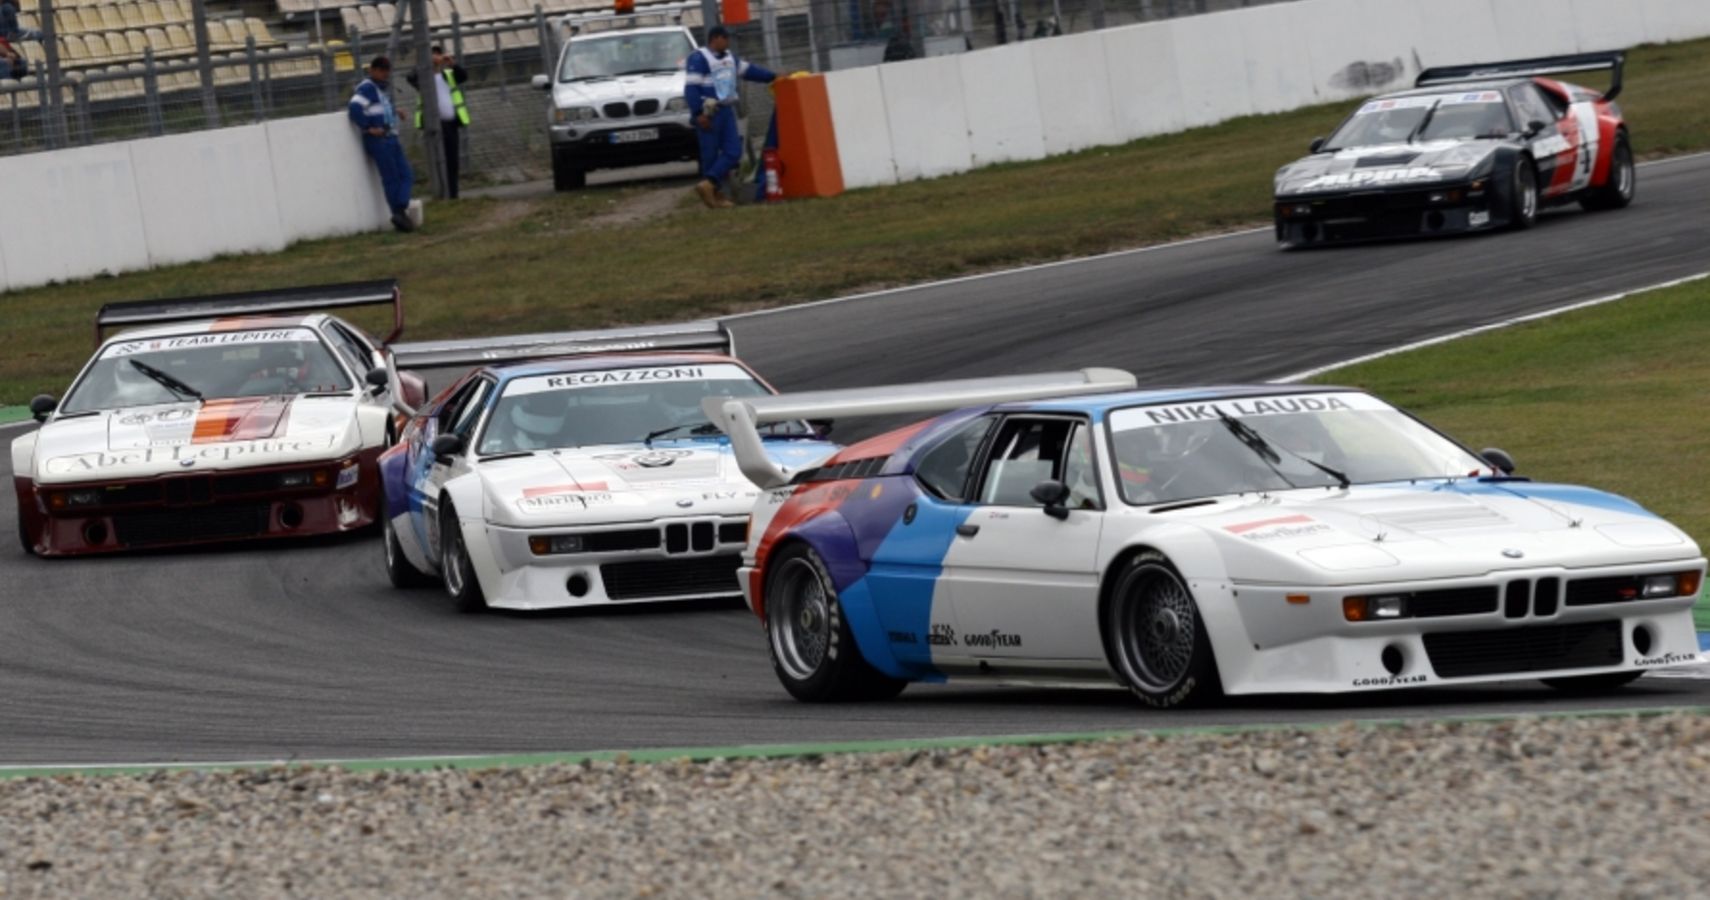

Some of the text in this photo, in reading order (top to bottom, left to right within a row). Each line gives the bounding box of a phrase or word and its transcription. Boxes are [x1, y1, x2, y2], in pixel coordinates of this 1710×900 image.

[167, 331, 295, 348] TEAM LEPITRE
[547, 367, 703, 388] REGAZZONI
[1145, 397, 1353, 424] NIKI LAUDA
[67, 449, 152, 472] Abel
[172, 439, 312, 461] Lepitre
[964, 628, 1022, 650] GOODYEAR
